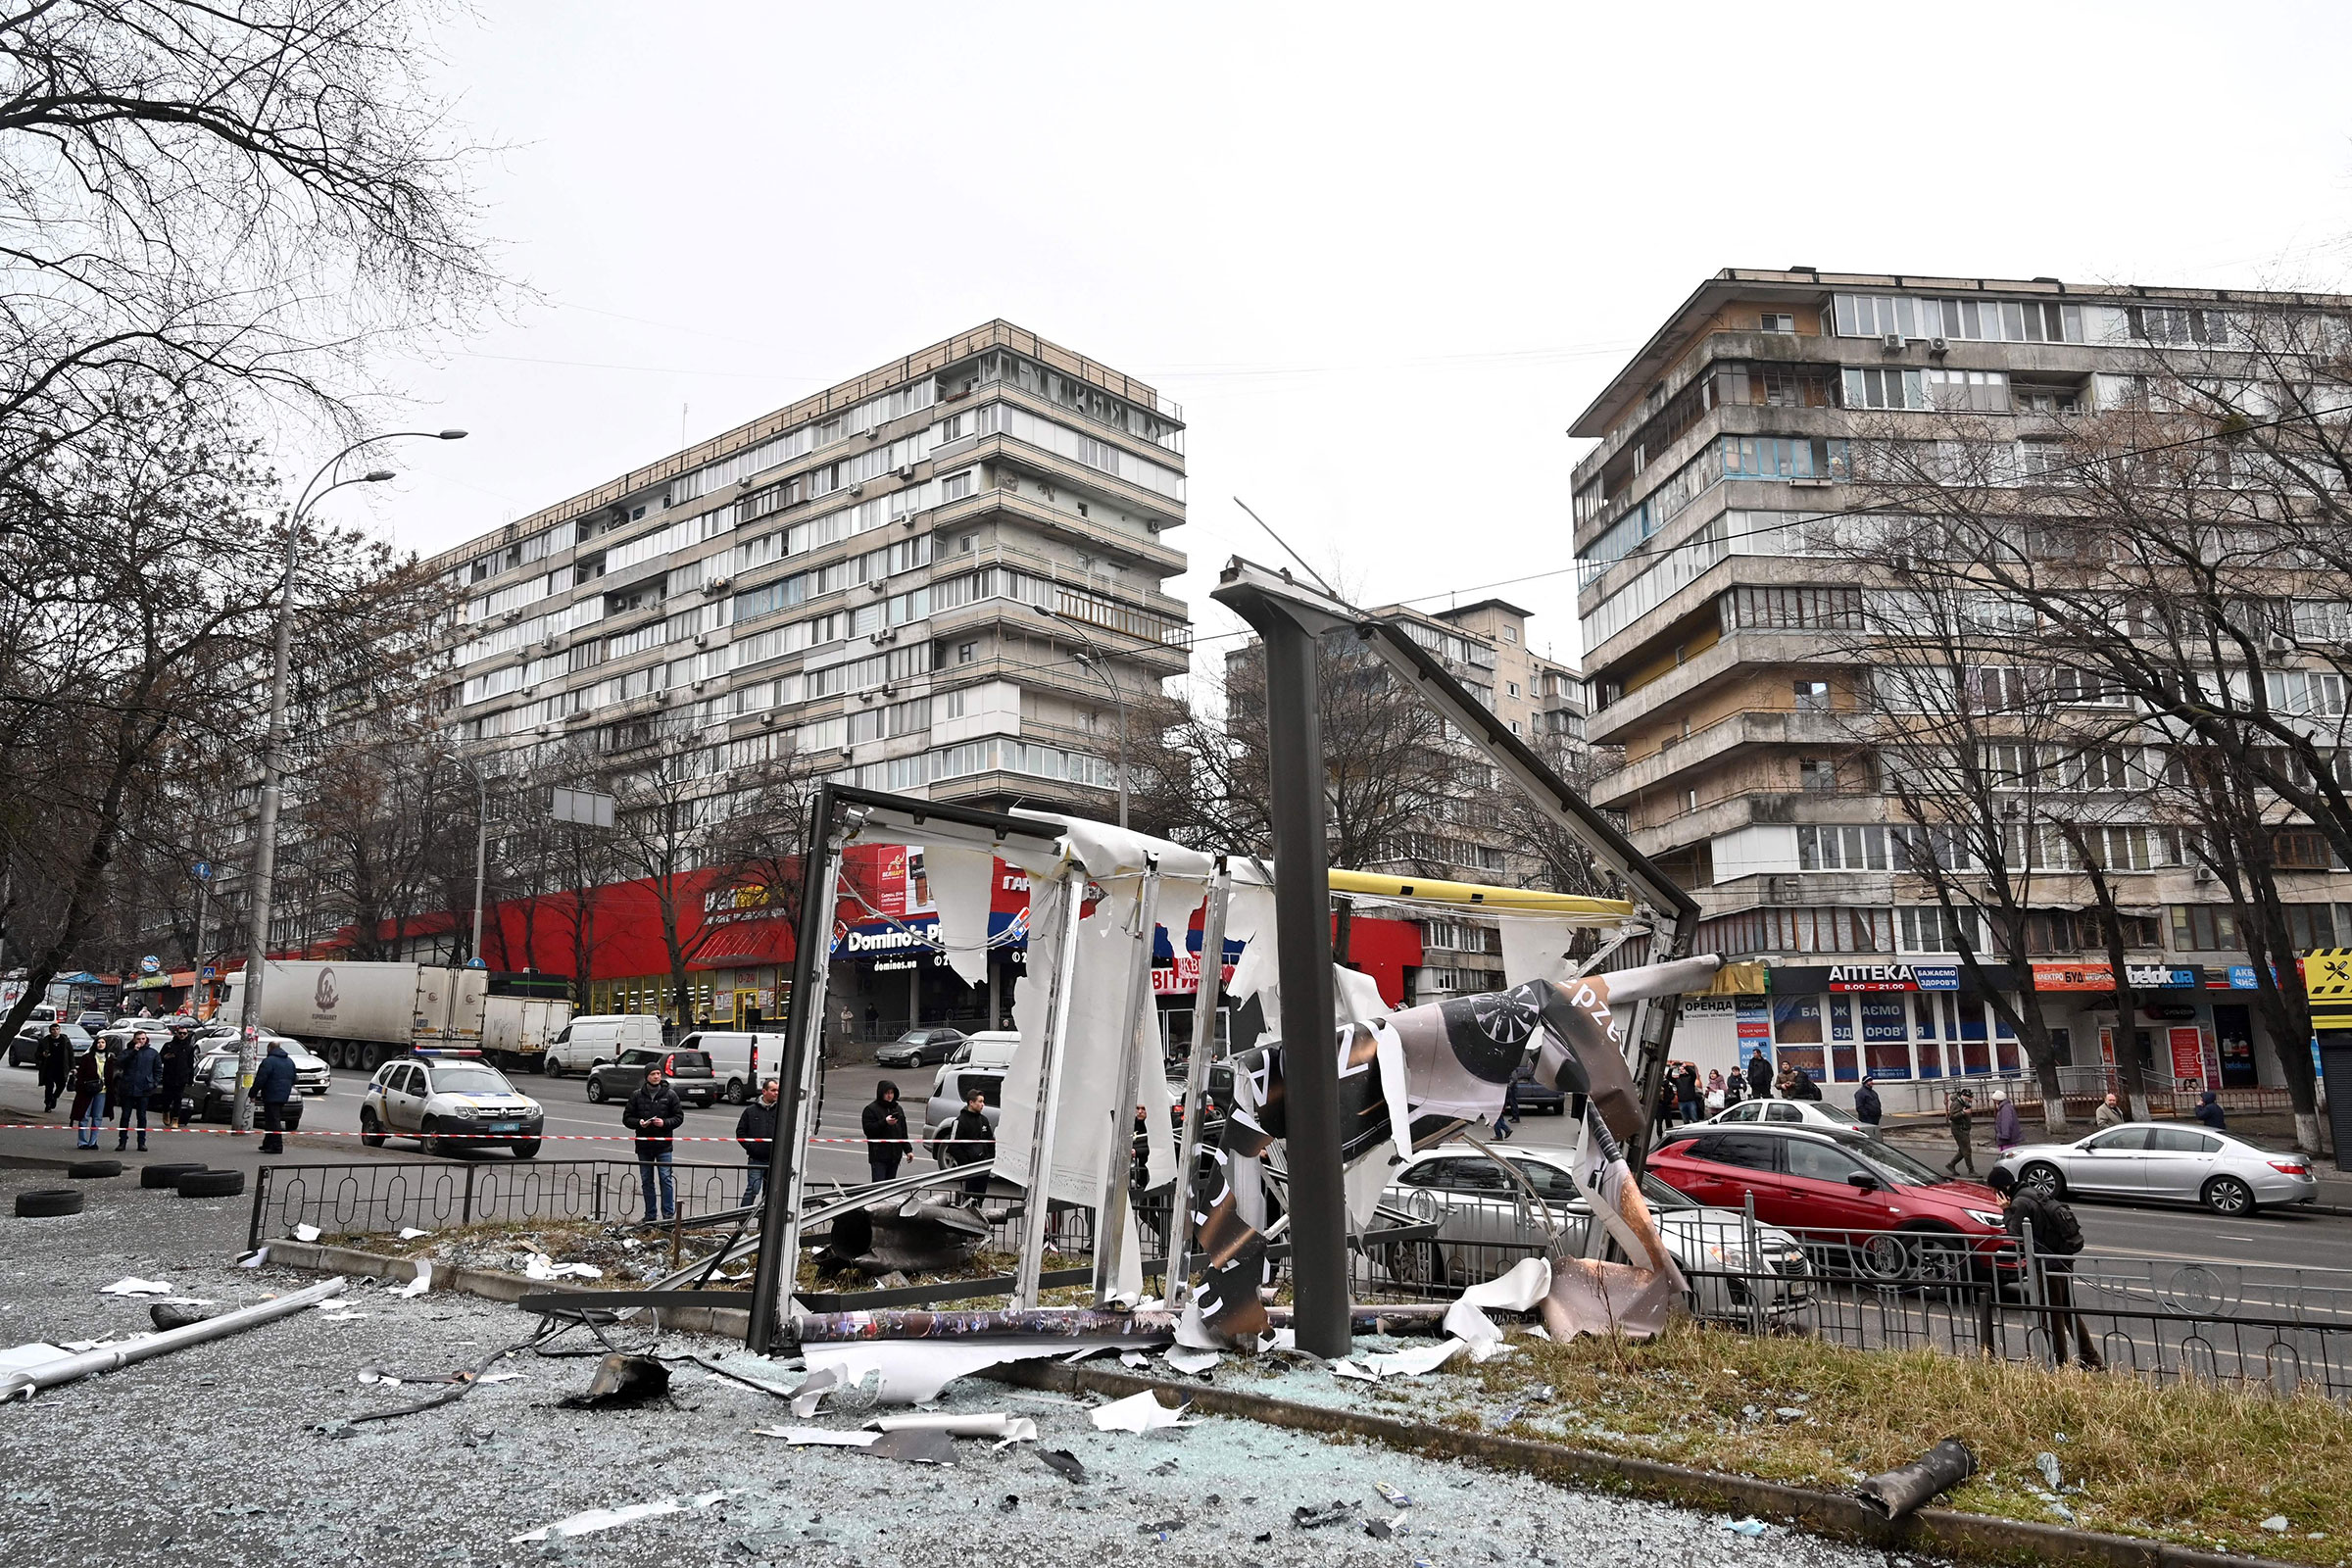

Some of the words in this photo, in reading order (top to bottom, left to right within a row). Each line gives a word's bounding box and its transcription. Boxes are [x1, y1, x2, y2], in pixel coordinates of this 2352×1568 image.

[848, 924, 926, 952] Domino's
[874, 959, 917, 972] dominos.ua
[738, 974, 756, 983] 0-24
[1829, 964, 1913, 981] АПТЕКА
[2065, 971, 2084, 983] БУД
[1685, 1001, 1733, 1011] ОРЕНДА
